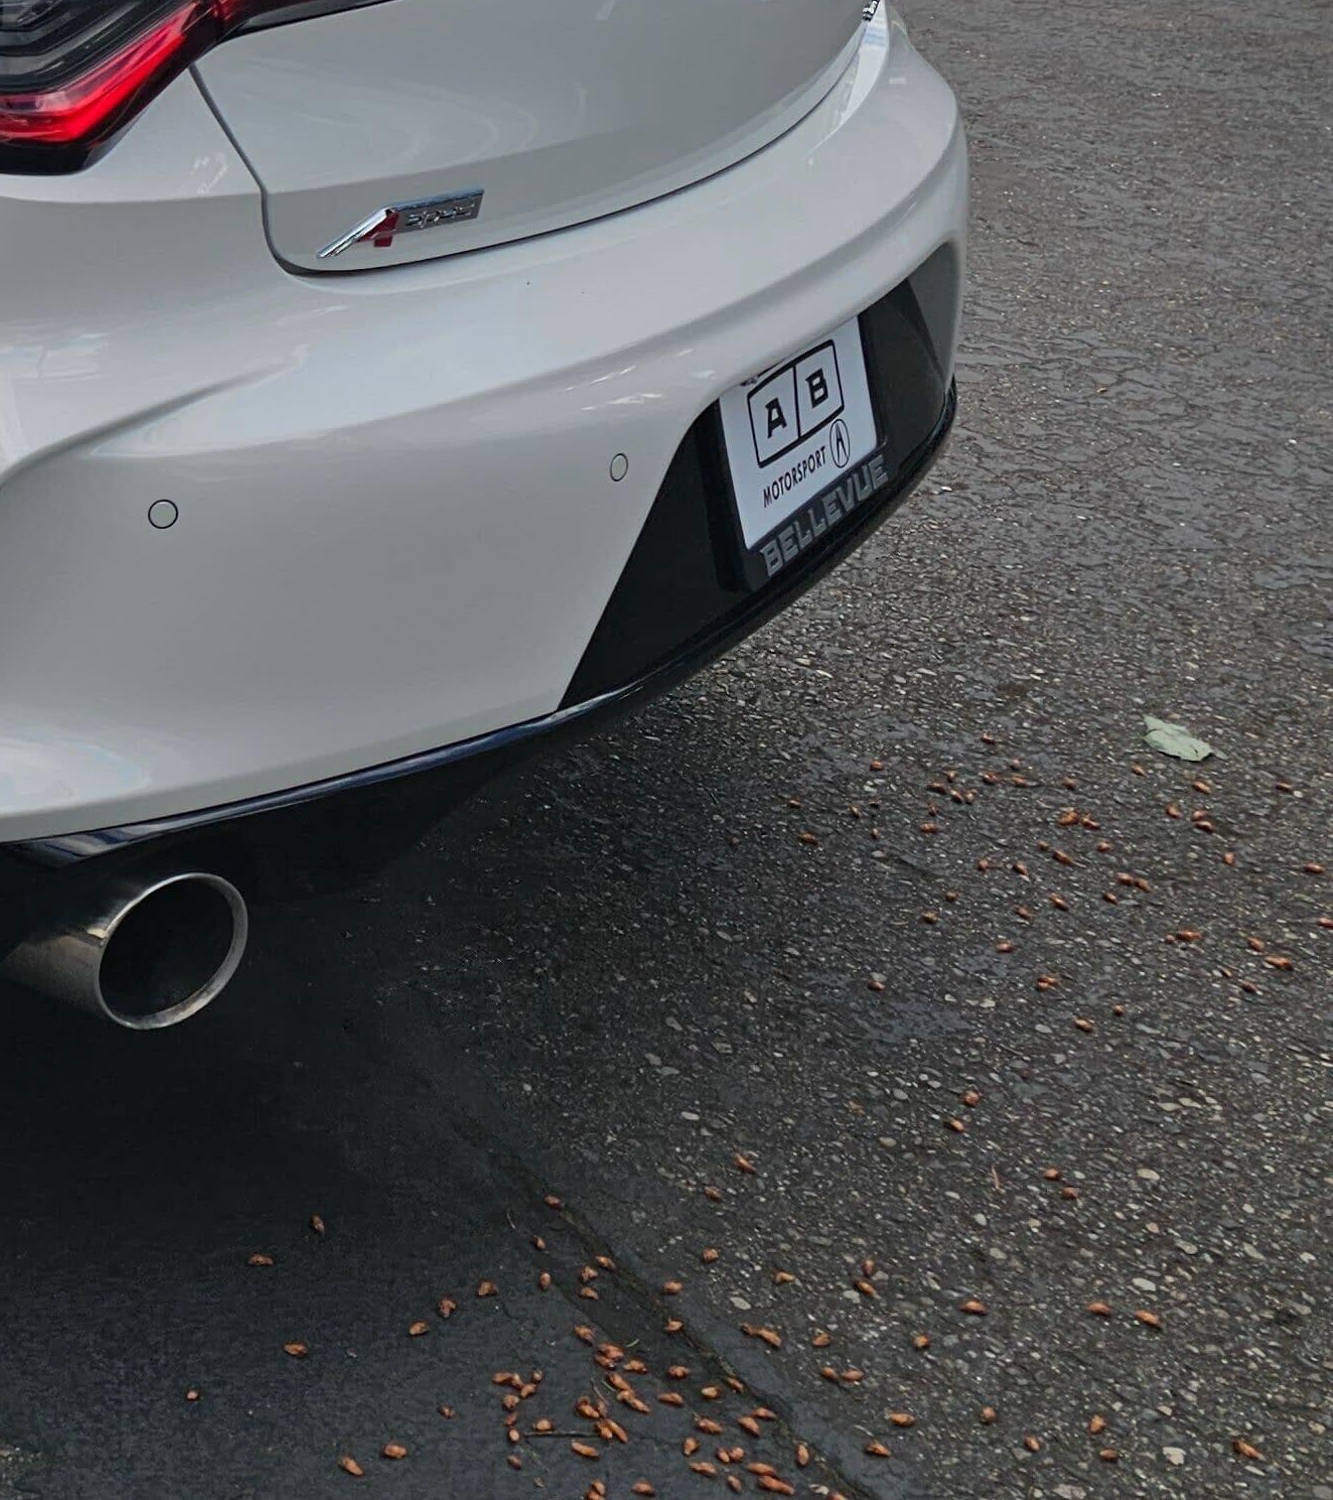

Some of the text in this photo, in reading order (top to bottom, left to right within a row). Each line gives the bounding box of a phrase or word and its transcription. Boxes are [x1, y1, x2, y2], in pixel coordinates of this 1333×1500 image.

[764, 367, 829, 440] A B
[762, 445, 827, 509] MOTORSPORT
[760, 453, 890, 577] BELLEVUE
